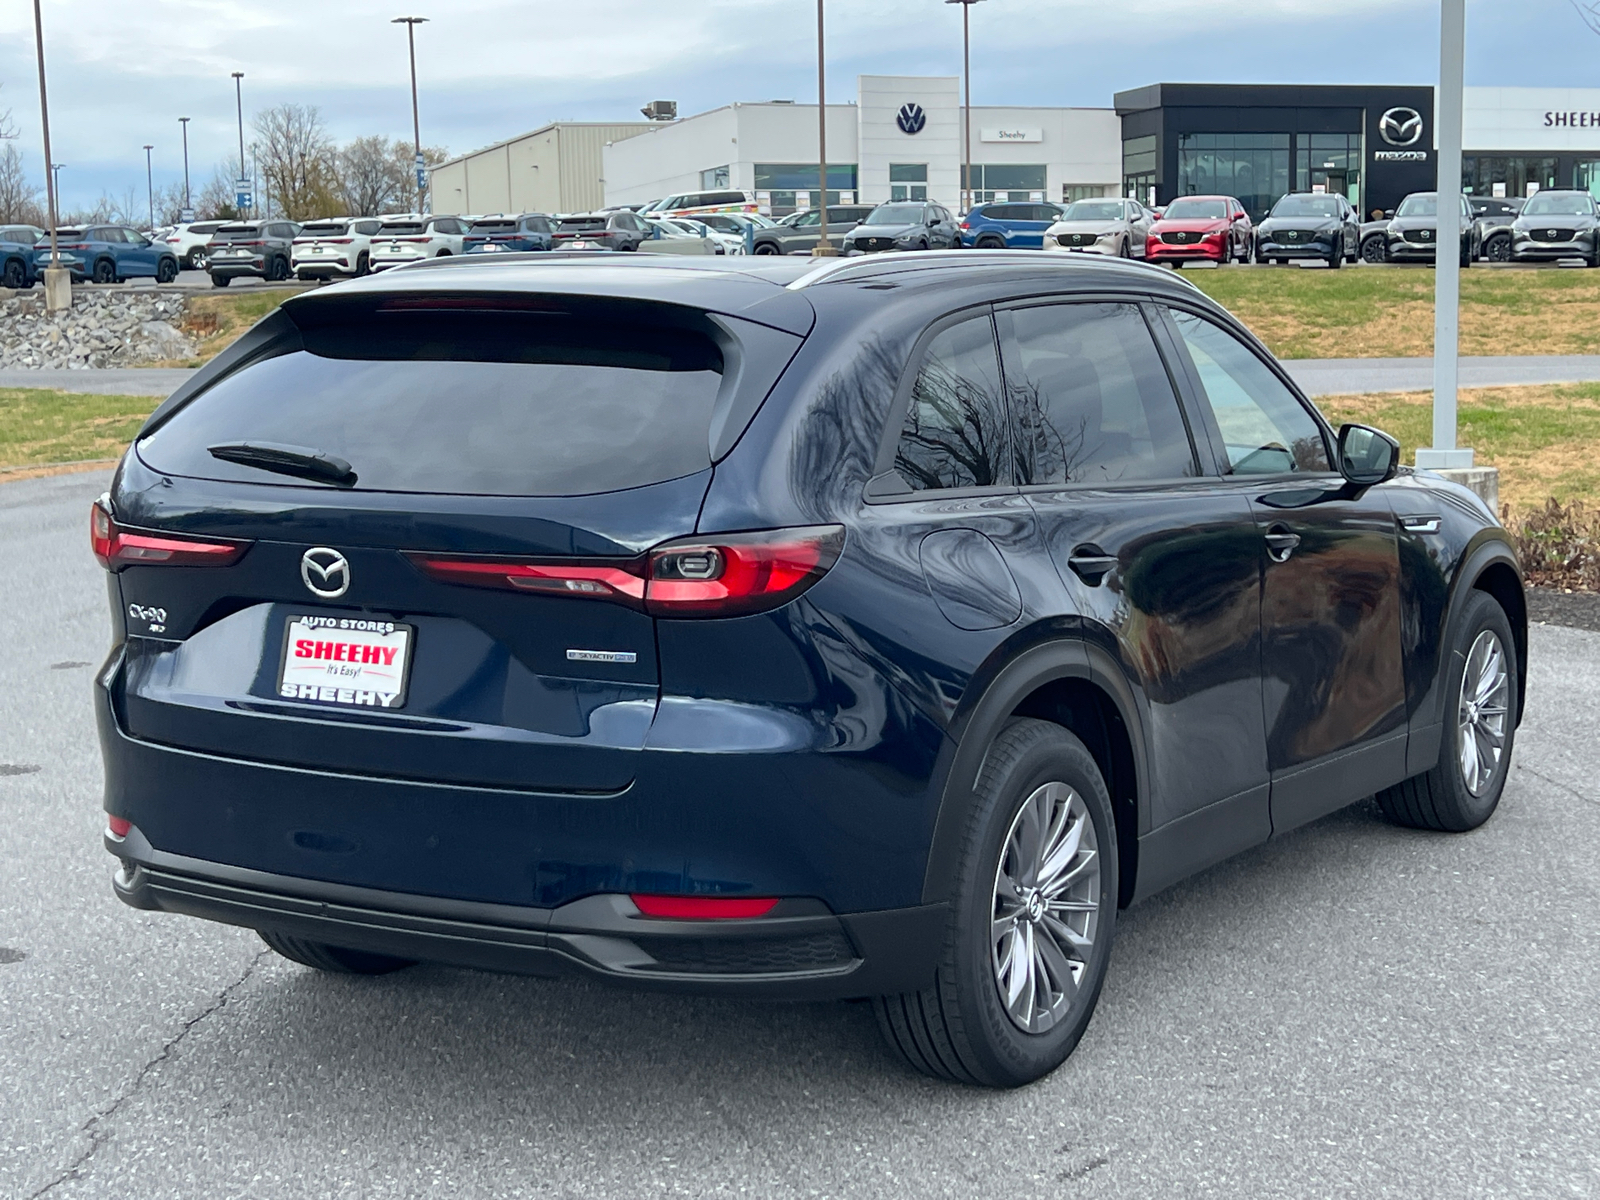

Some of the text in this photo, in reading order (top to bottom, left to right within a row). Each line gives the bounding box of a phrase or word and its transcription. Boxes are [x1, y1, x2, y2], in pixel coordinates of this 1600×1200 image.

[998, 130, 1026, 140] Sheehy
[129, 603, 167, 622] CX-90
[300, 616, 394, 633] AUTO STORES
[295, 639, 399, 665] SHEEHY
[327, 663, 362, 679] It's Easy!
[281, 683, 398, 707] SHEEHY
